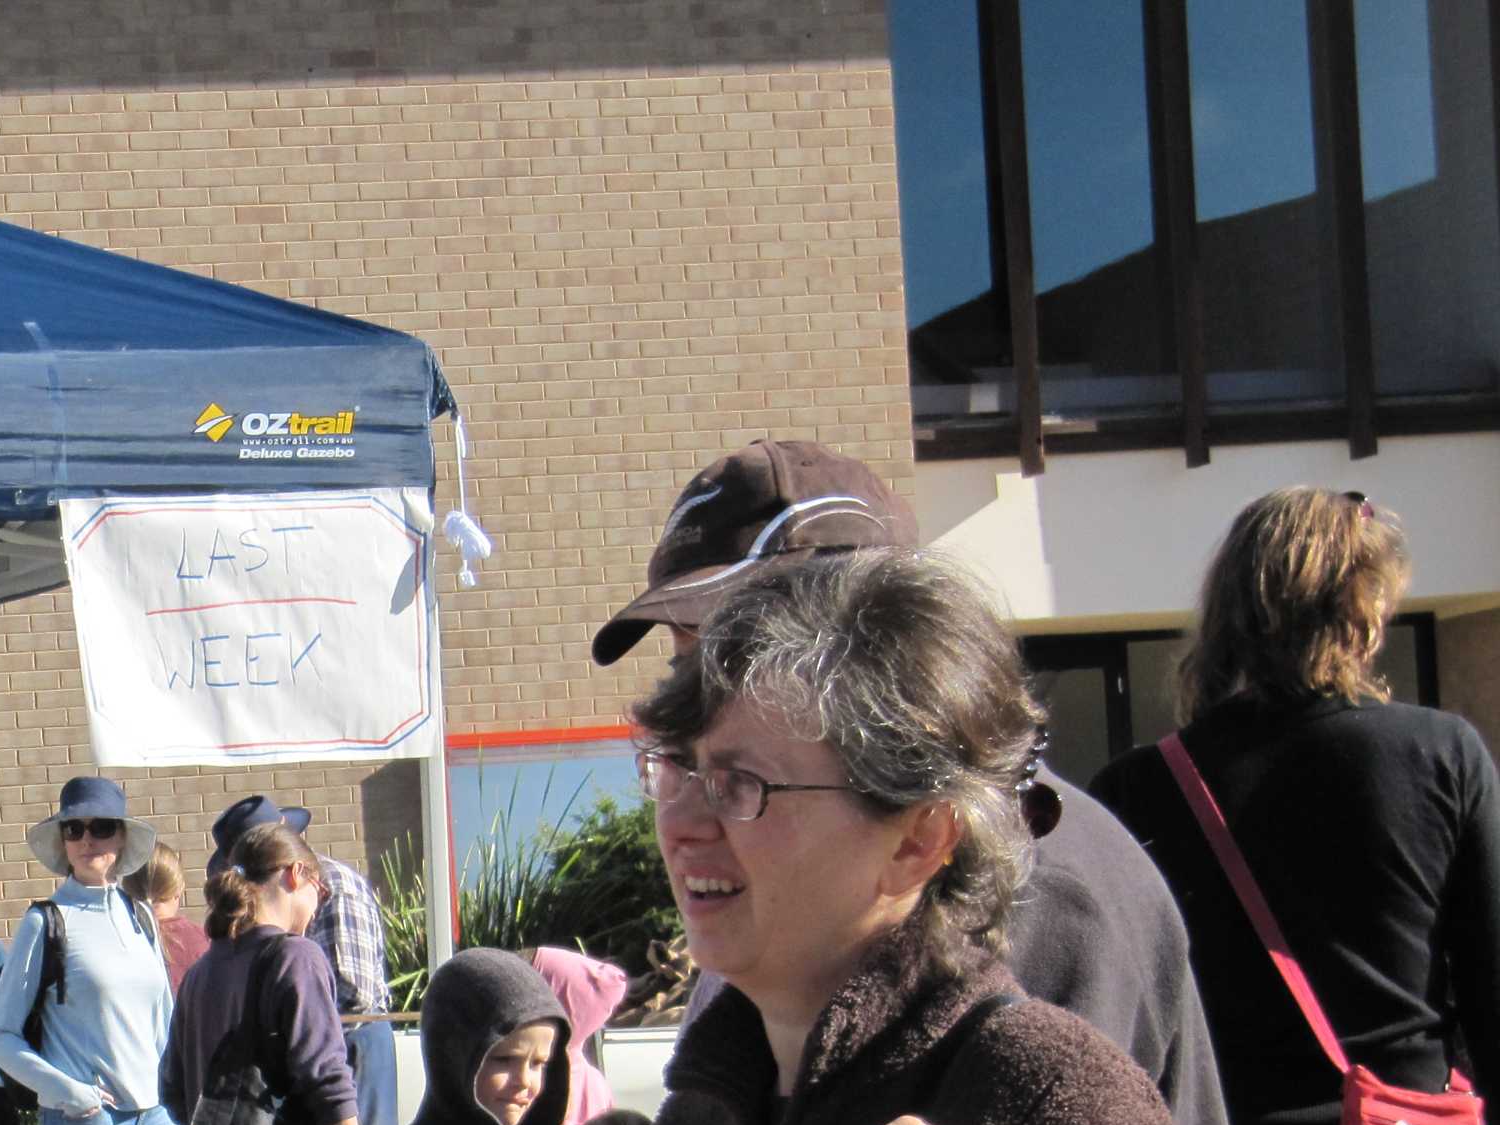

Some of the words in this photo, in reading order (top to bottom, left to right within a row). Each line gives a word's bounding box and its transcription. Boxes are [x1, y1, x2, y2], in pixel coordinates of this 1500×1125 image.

[241, 411, 355, 436] OZtrail
[239, 448, 293, 460] Deluxe
[296, 447, 355, 460] Gazebo
[242, 436, 354, 446] www.oztrail.com.au
[176, 526, 314, 580] LAST
[154, 631, 323, 690] WEEK
